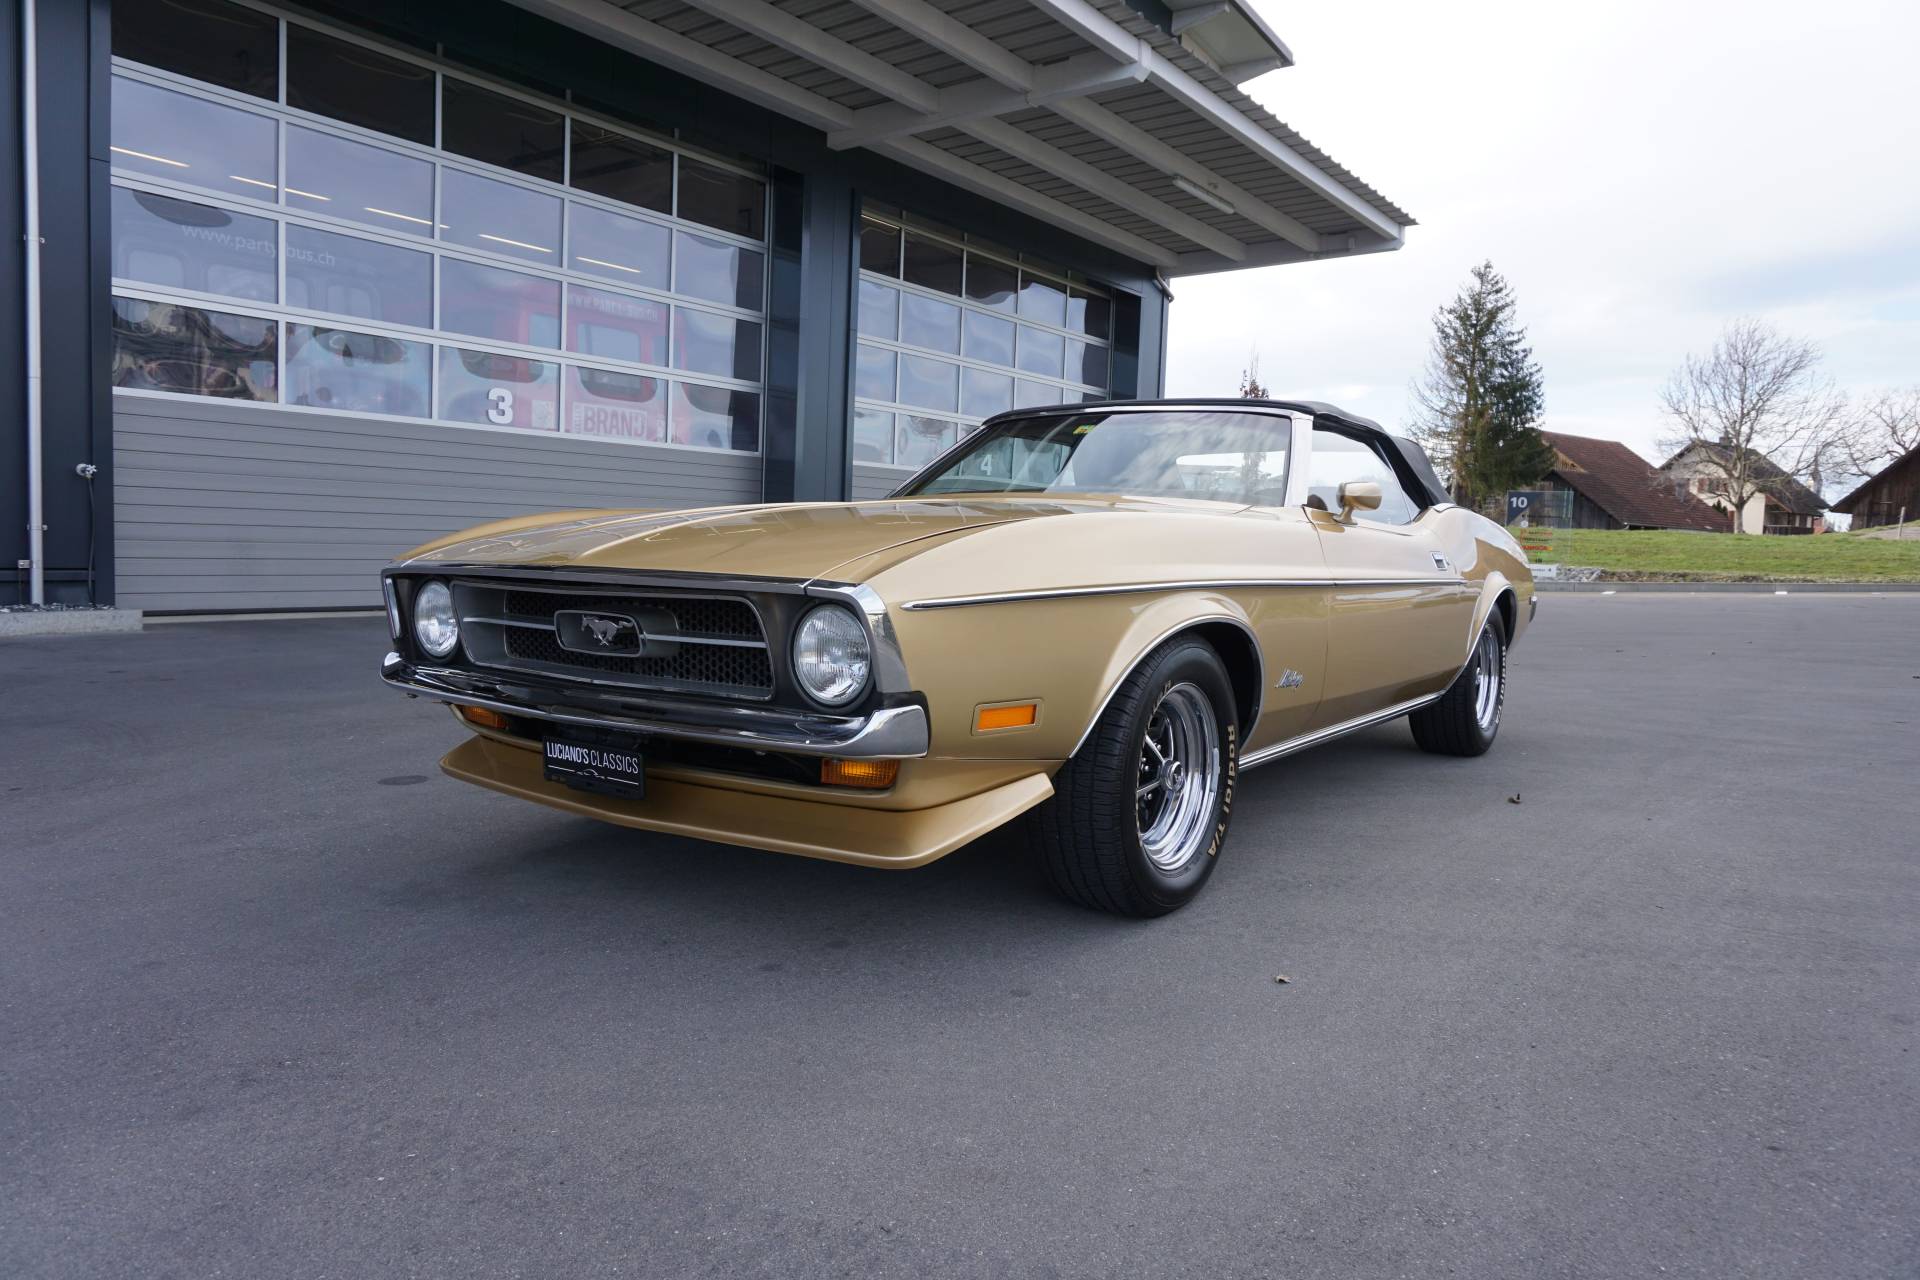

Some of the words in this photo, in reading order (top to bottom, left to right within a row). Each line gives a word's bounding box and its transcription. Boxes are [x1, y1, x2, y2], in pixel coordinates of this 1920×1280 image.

[487, 387, 514, 425] 3
[980, 454, 993, 476] 4
[1510, 496, 1528, 508] 10
[546, 741, 589, 764] LUCIANO'S
[590, 750, 639, 774] CLASSICS
